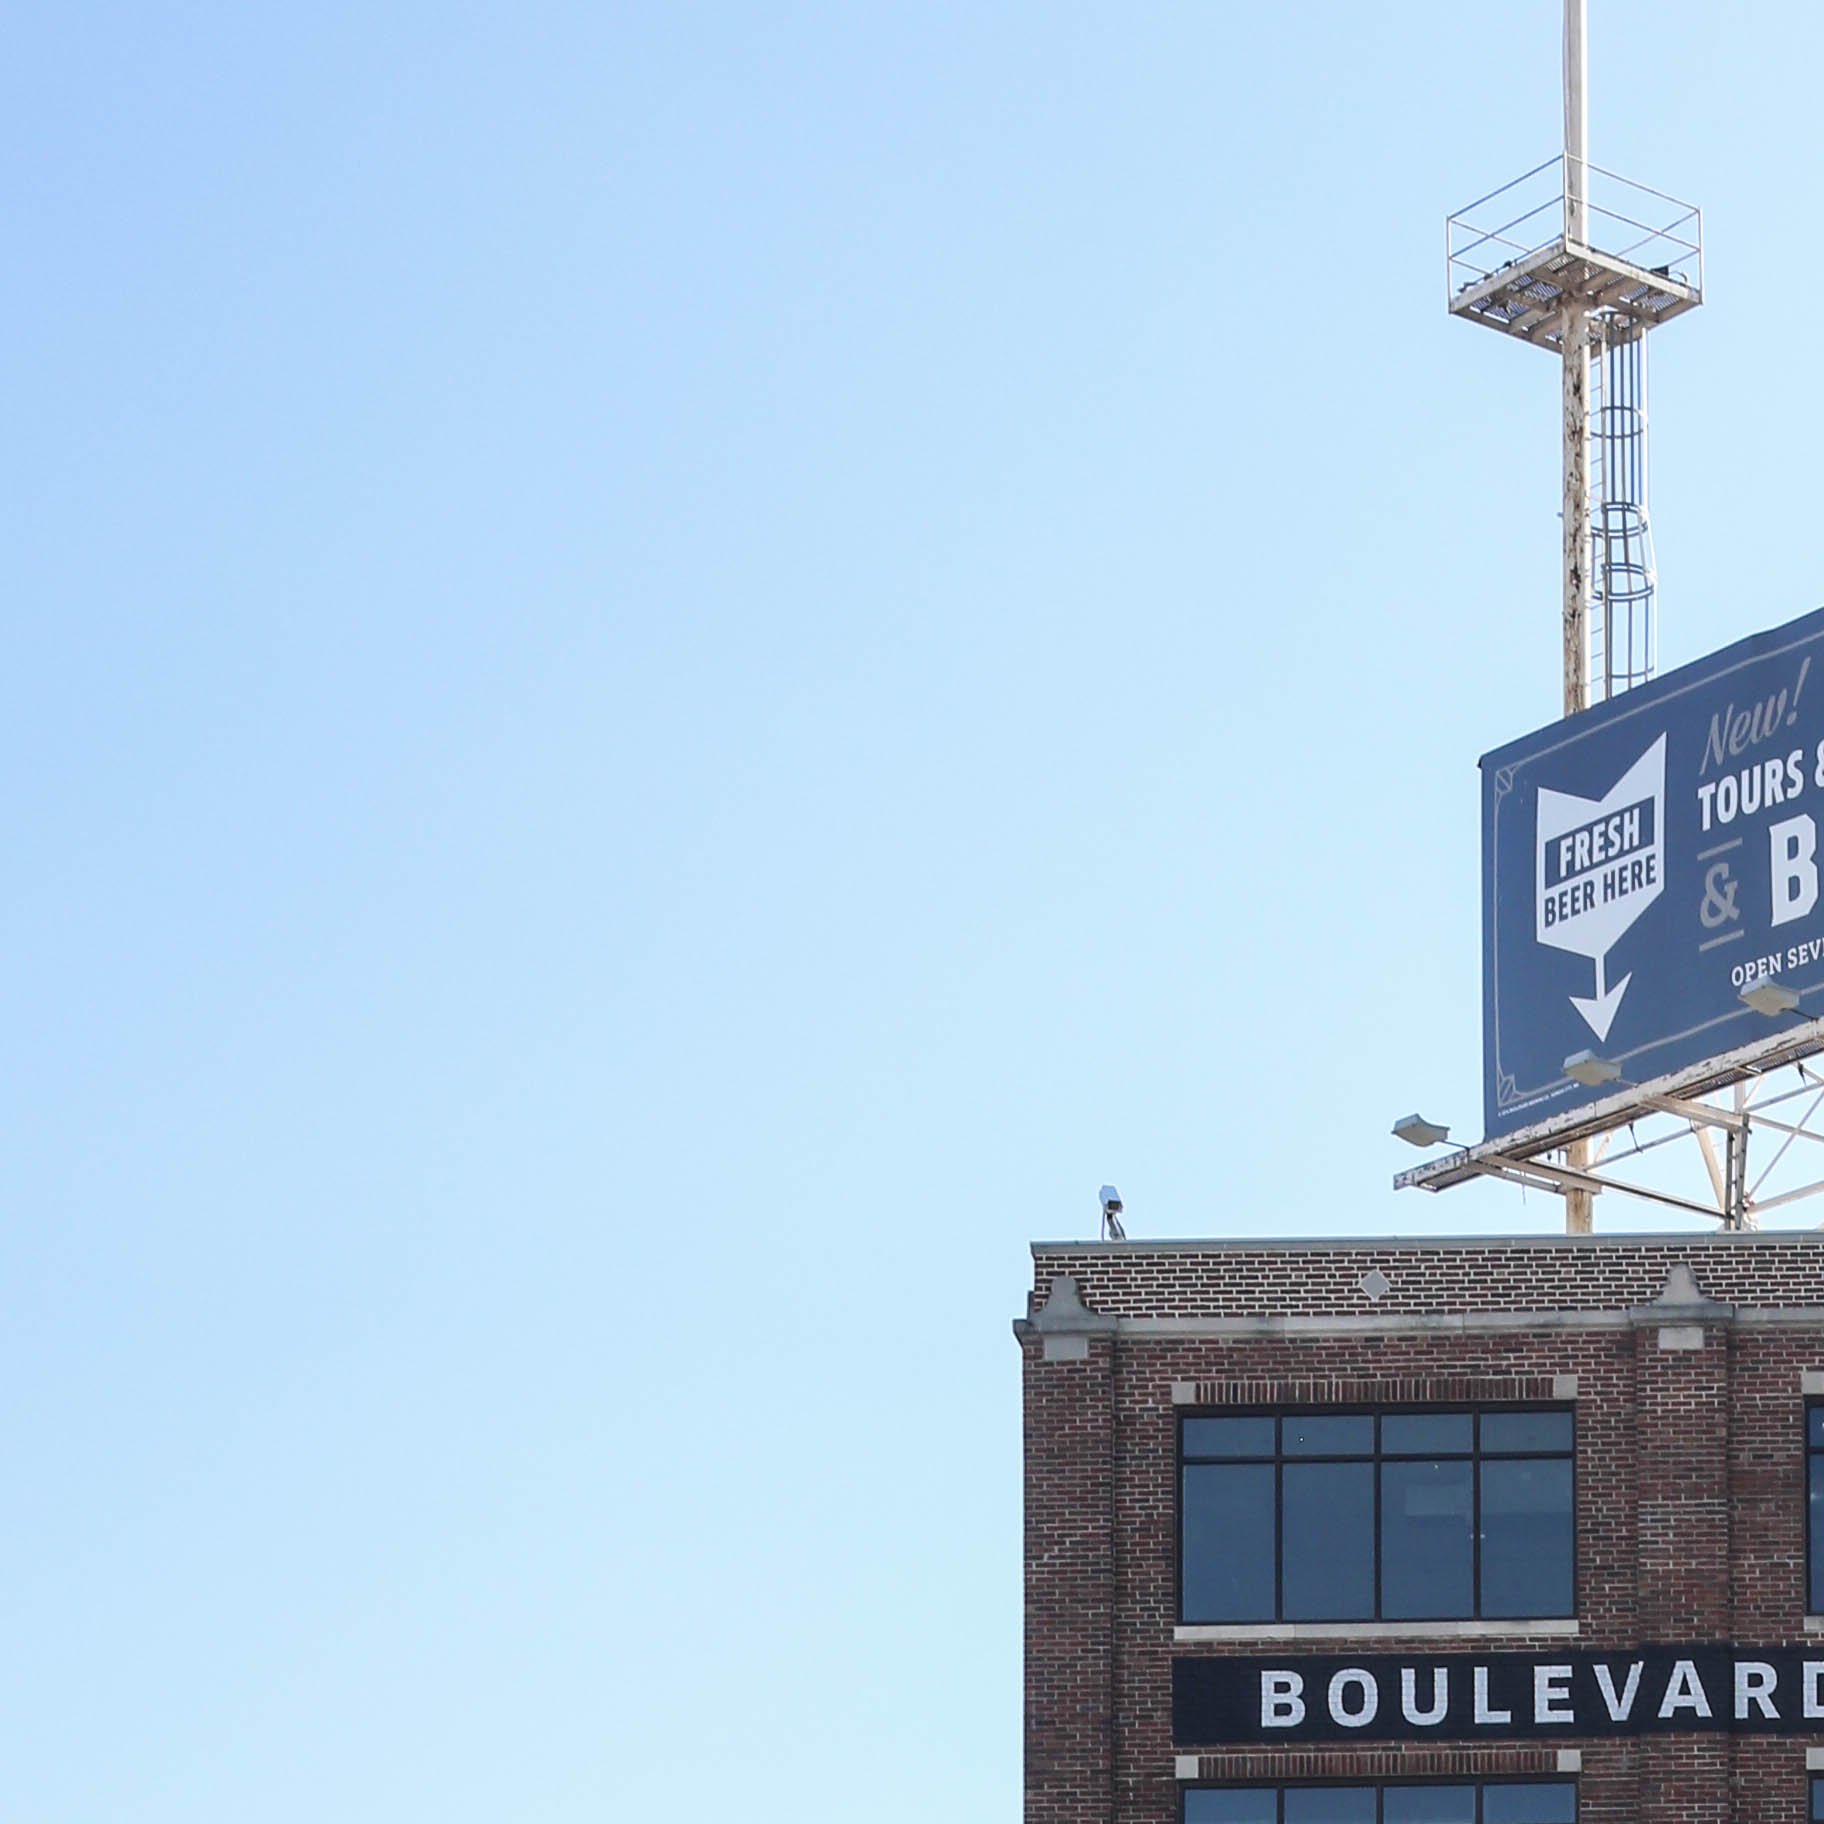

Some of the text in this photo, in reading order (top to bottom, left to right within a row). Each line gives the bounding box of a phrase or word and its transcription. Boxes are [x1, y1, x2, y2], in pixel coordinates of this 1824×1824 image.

[1700, 657, 1811, 776] New!
[1697, 749, 1804, 831] TOURS
[1559, 807, 1640, 878] FRESH
[1544, 853, 1657, 929] BEER HERE
[1699, 862, 1741, 928] &
[1731, 956, 1783, 987] OPEN
